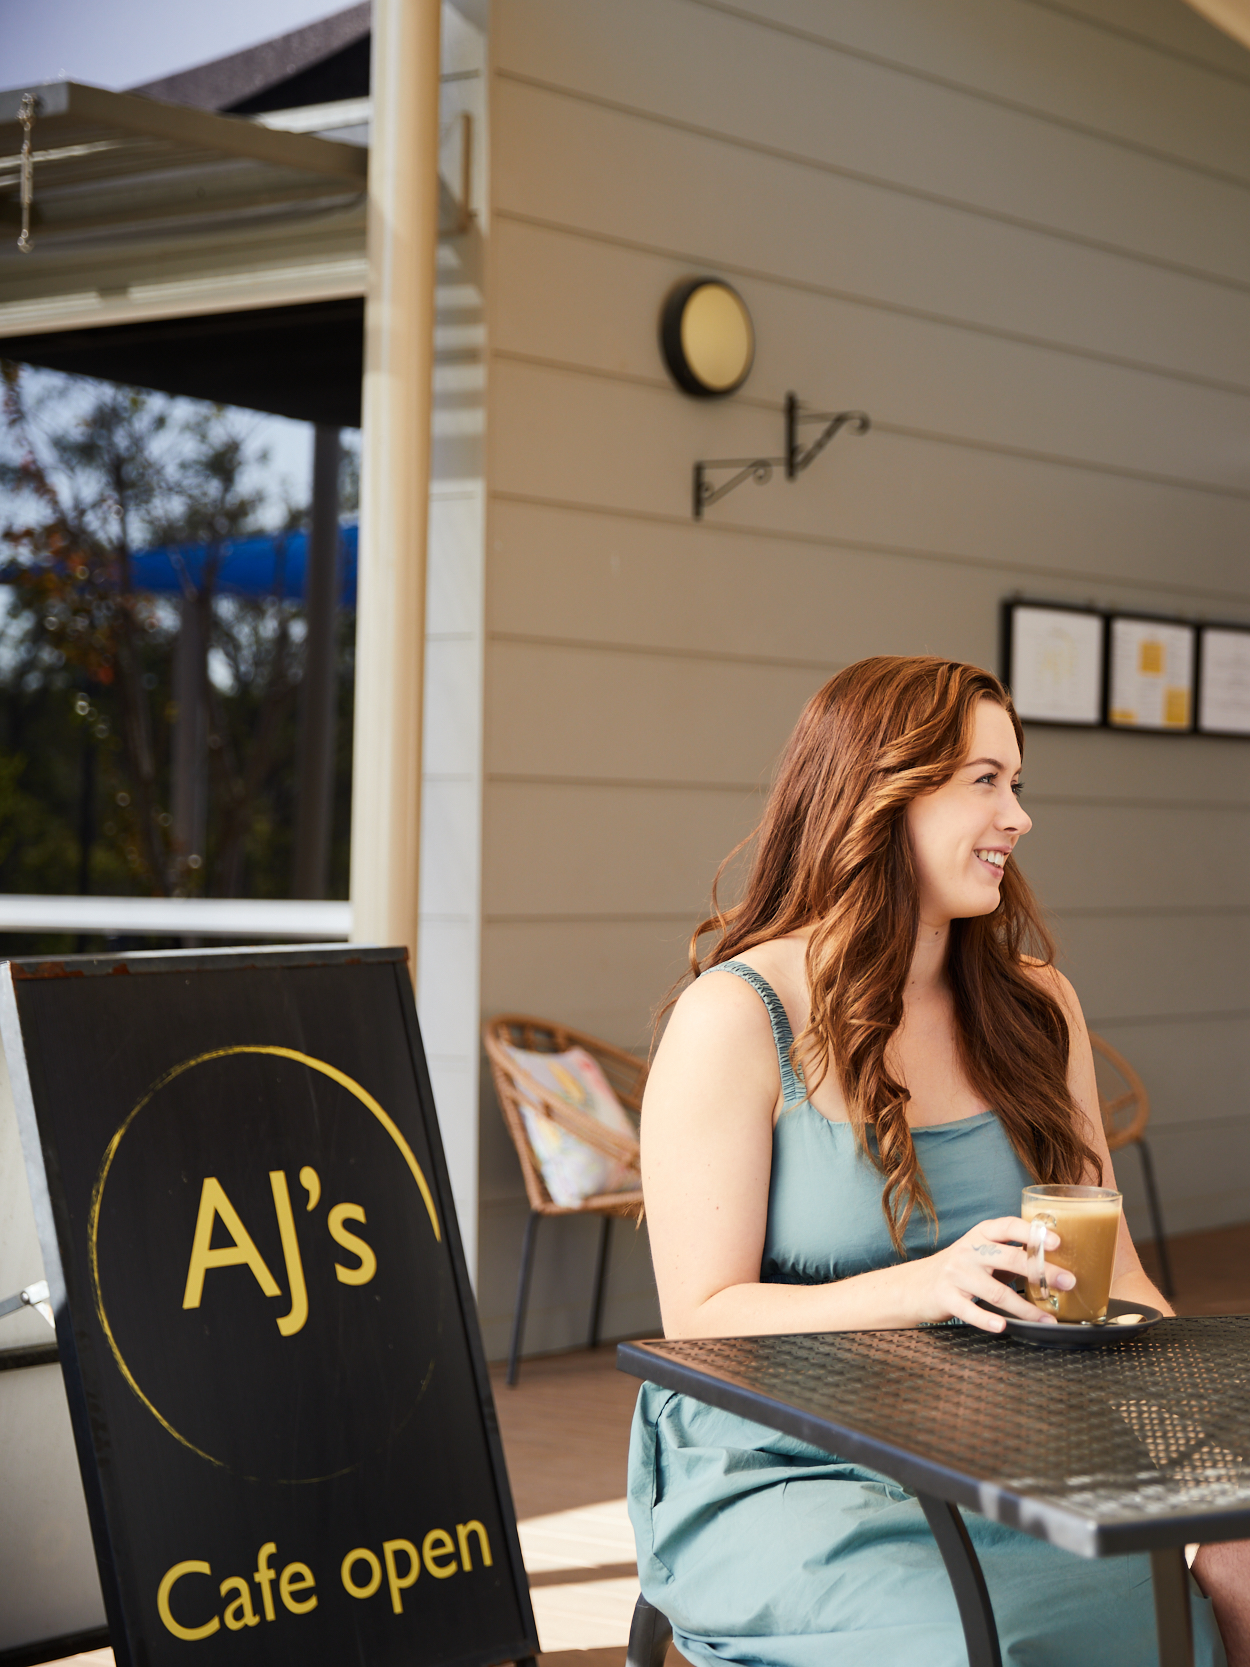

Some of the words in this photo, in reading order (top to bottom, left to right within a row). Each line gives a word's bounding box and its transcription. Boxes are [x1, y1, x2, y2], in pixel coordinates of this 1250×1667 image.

[182, 1165, 378, 1337] AJ's
[156, 1541, 318, 1641] Cafe
[340, 1519, 493, 1615] open
